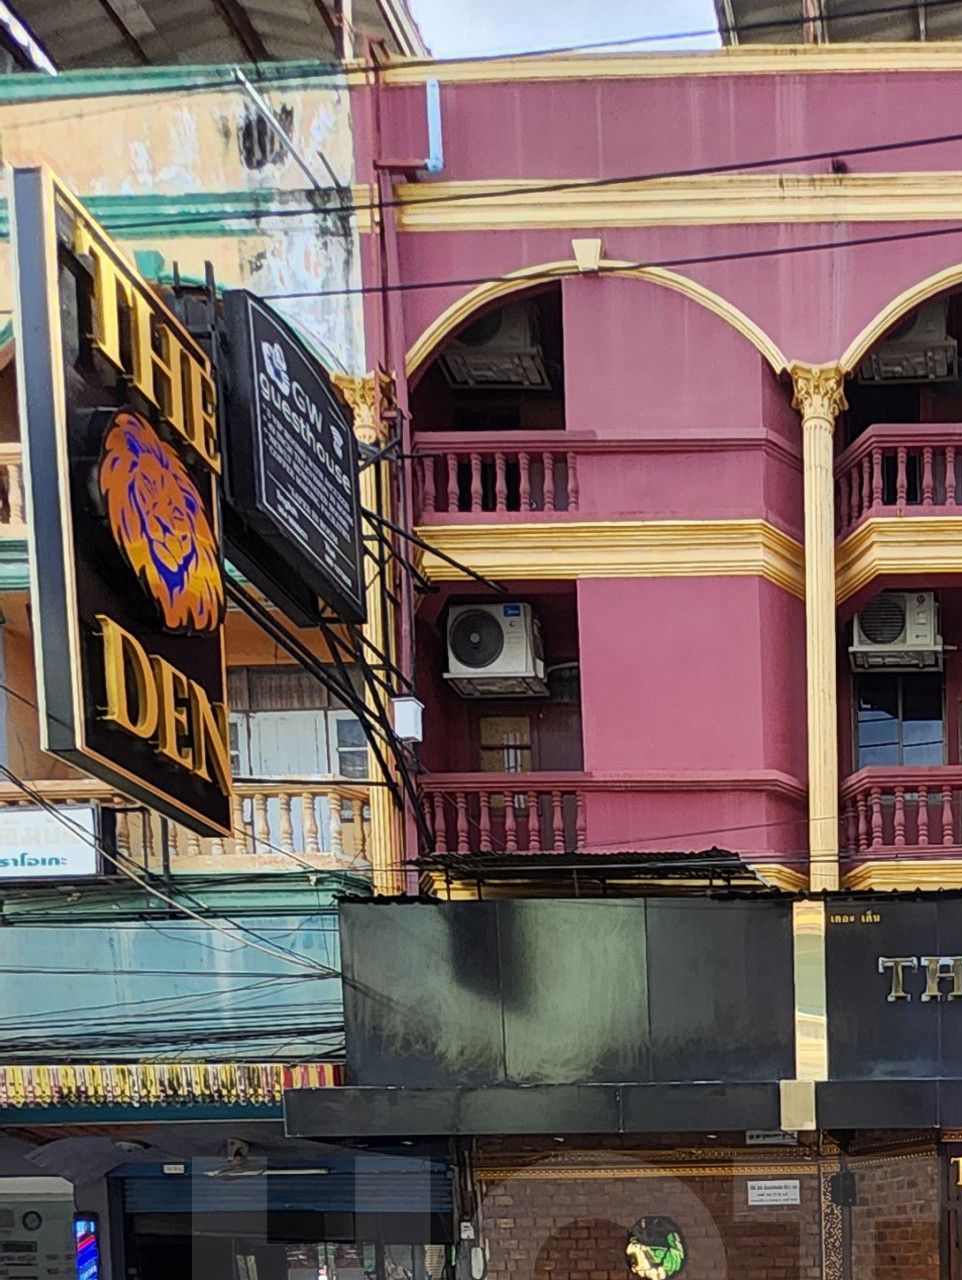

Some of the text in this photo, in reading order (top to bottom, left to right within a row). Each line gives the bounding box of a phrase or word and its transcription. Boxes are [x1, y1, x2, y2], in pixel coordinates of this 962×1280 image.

[72, 217, 221, 476] THE
[292, 381, 322, 433] GW
[260, 372, 352, 496] guesthouse
[94, 614, 231, 797] DEN
